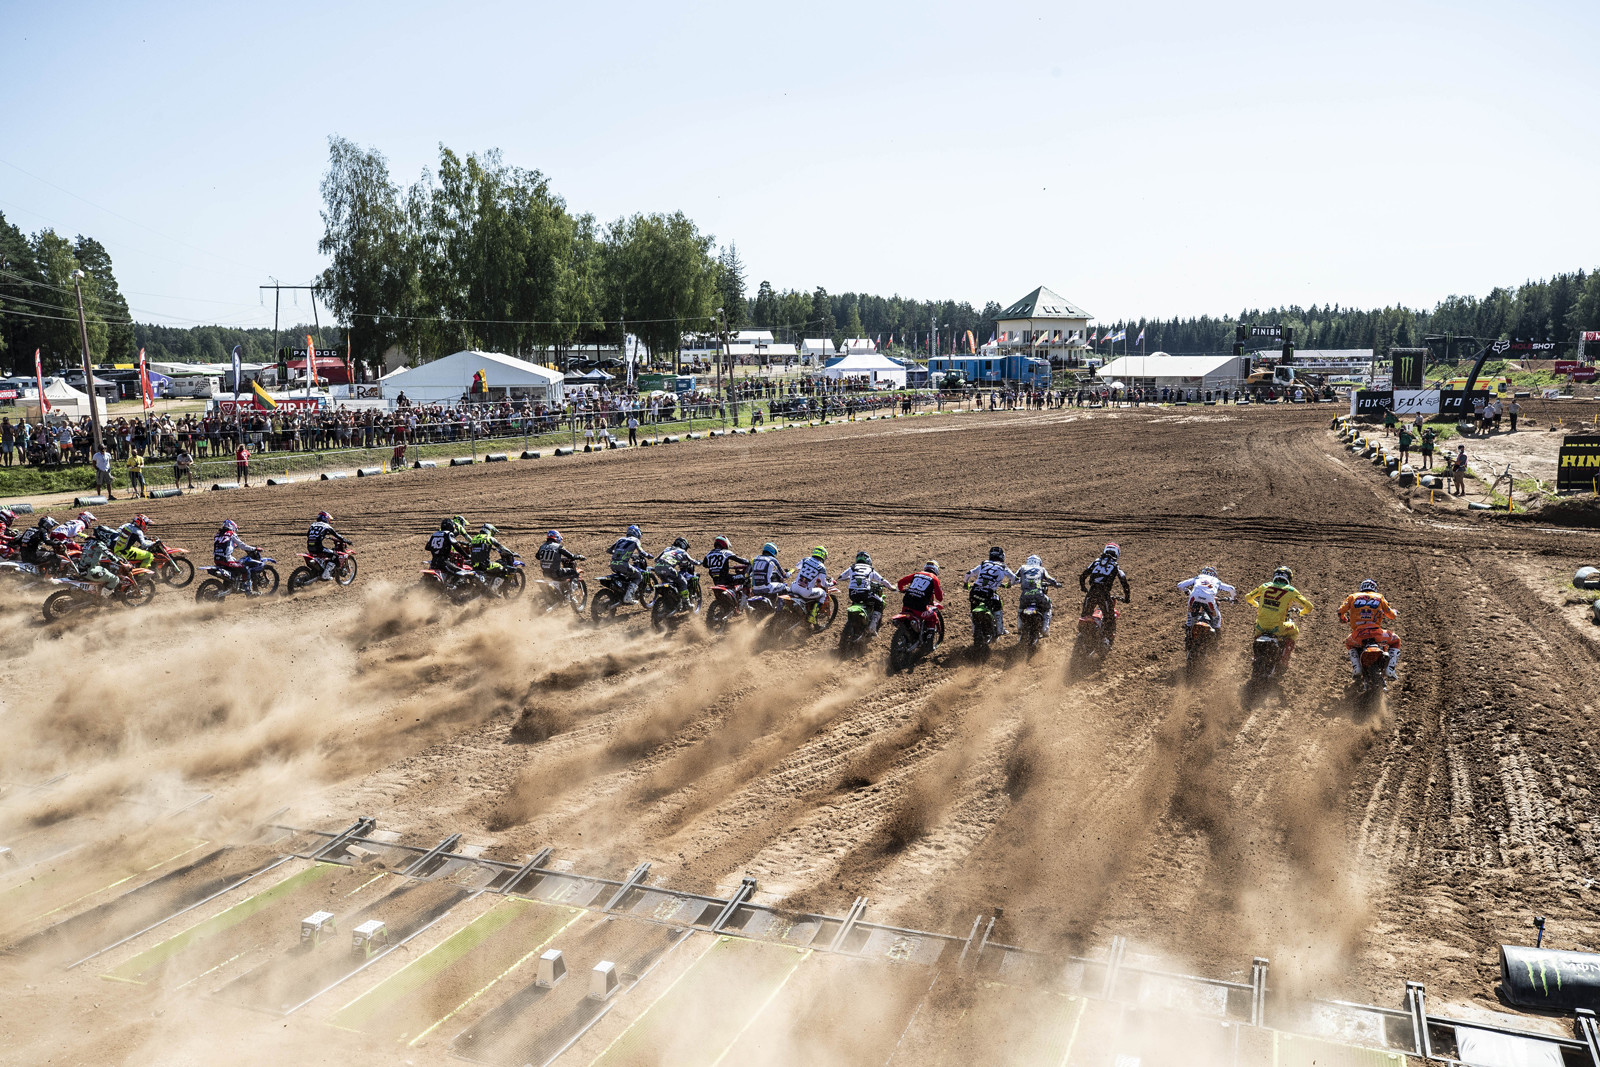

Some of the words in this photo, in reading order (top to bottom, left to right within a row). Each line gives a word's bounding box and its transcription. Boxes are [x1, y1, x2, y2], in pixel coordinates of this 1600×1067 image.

[1252, 328, 1281, 336] FINISH
[1358, 399, 1379, 408] FOX
[1397, 398, 1424, 407] FOX
[1263, 586, 1289, 601] 27
